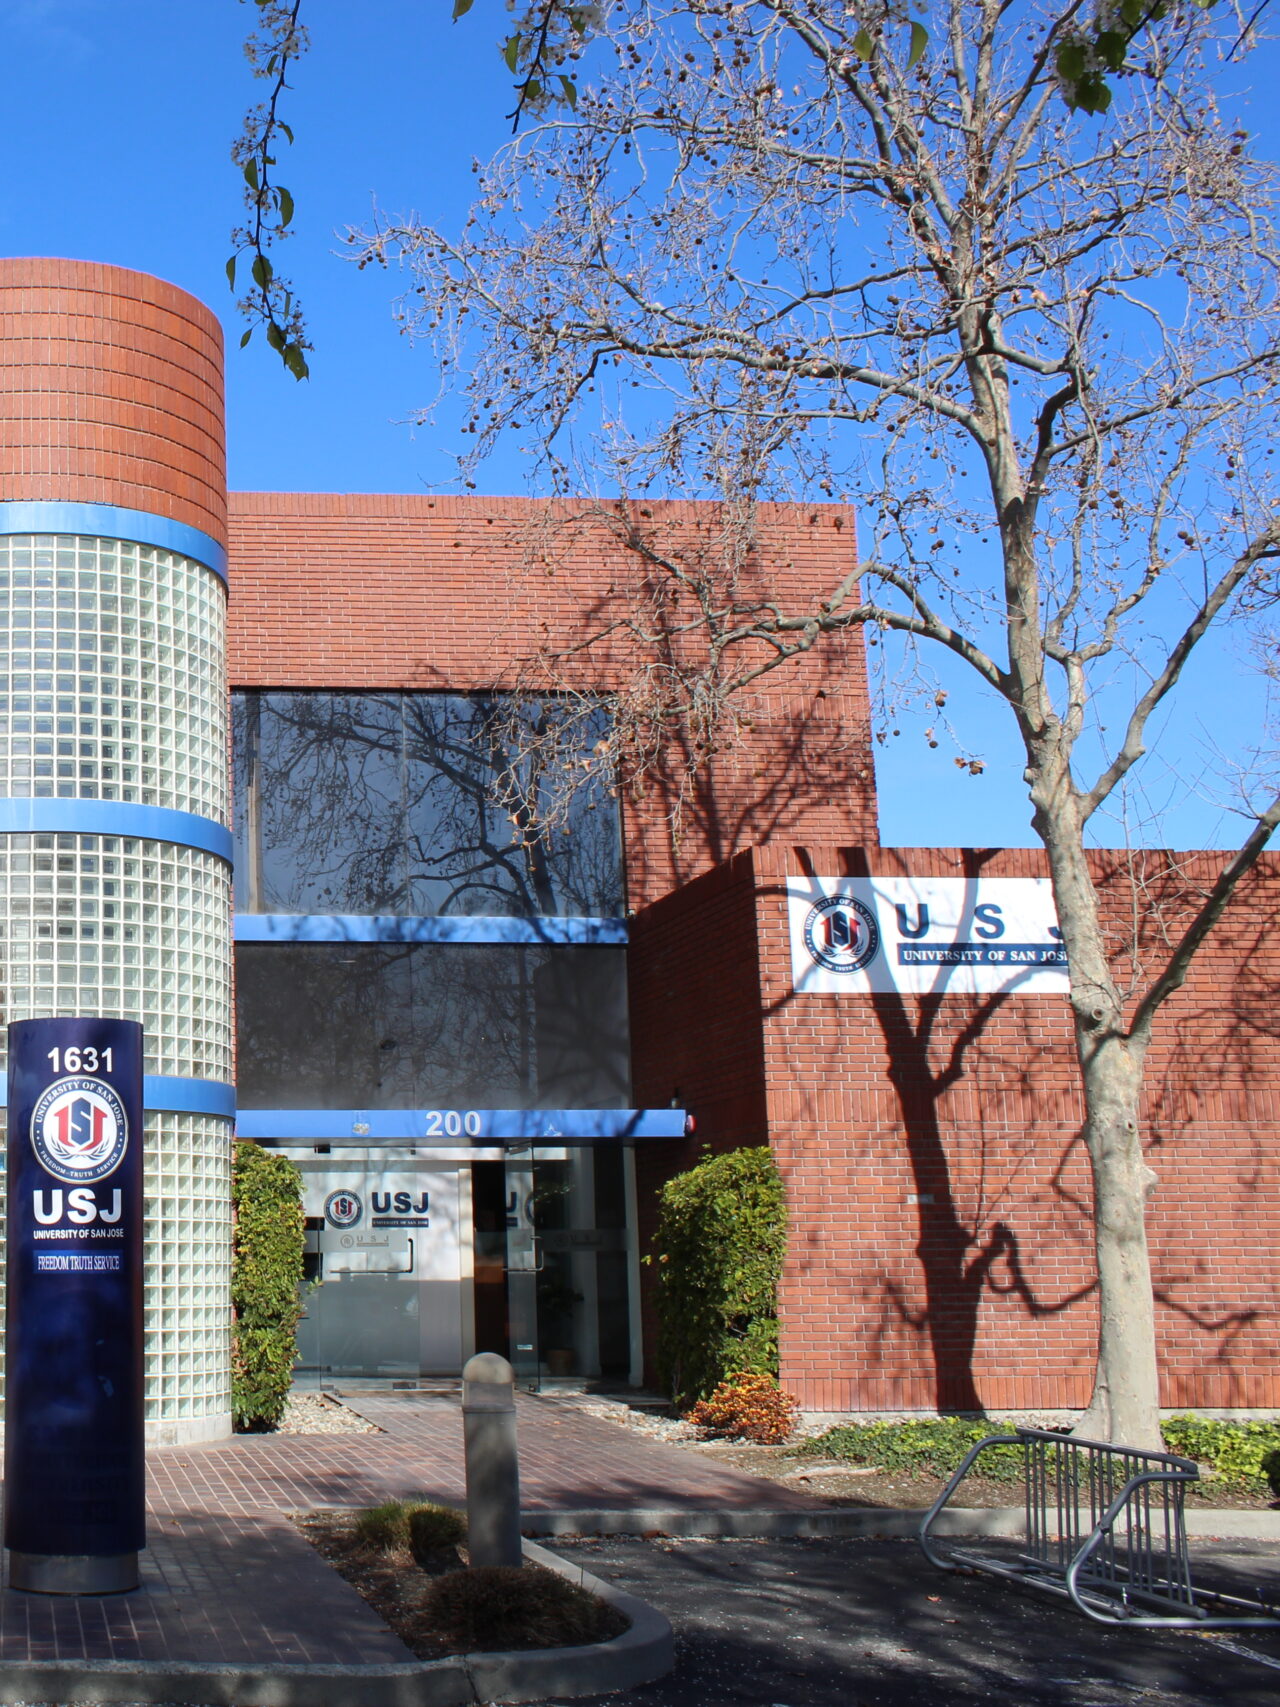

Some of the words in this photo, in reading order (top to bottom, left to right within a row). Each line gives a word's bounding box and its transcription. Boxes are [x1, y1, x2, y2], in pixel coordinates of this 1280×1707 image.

[903, 950, 983, 961] UNIVERSITY
[988, 950, 1007, 961] OF
[1010, 950, 1036, 961] SAN
[47, 1046, 113, 1073] 1631
[35, 1081, 80, 1123] UNIVERSITY
[82, 1081, 96, 1090] OF
[96, 1086, 114, 1102] SAN
[110, 1102, 124, 1126] JOSE
[425, 1110, 481, 1137] 200
[40, 1151, 66, 1174] FREEDOM
[96, 1152, 118, 1174] SERVICE
[33, 1187, 122, 1225] USJ
[371, 1191, 429, 1214] USJ
[33, 1229, 78, 1240] UNIVERSITY
[79, 1229, 90, 1239] OF
[90, 1228, 106, 1238] SAN
[106, 1228, 124, 1238] JOSE
[37, 1255, 69, 1271] FREEDOM
[69, 1255, 93, 1271] TRUTH
[93, 1255, 120, 1270] SERVICE
